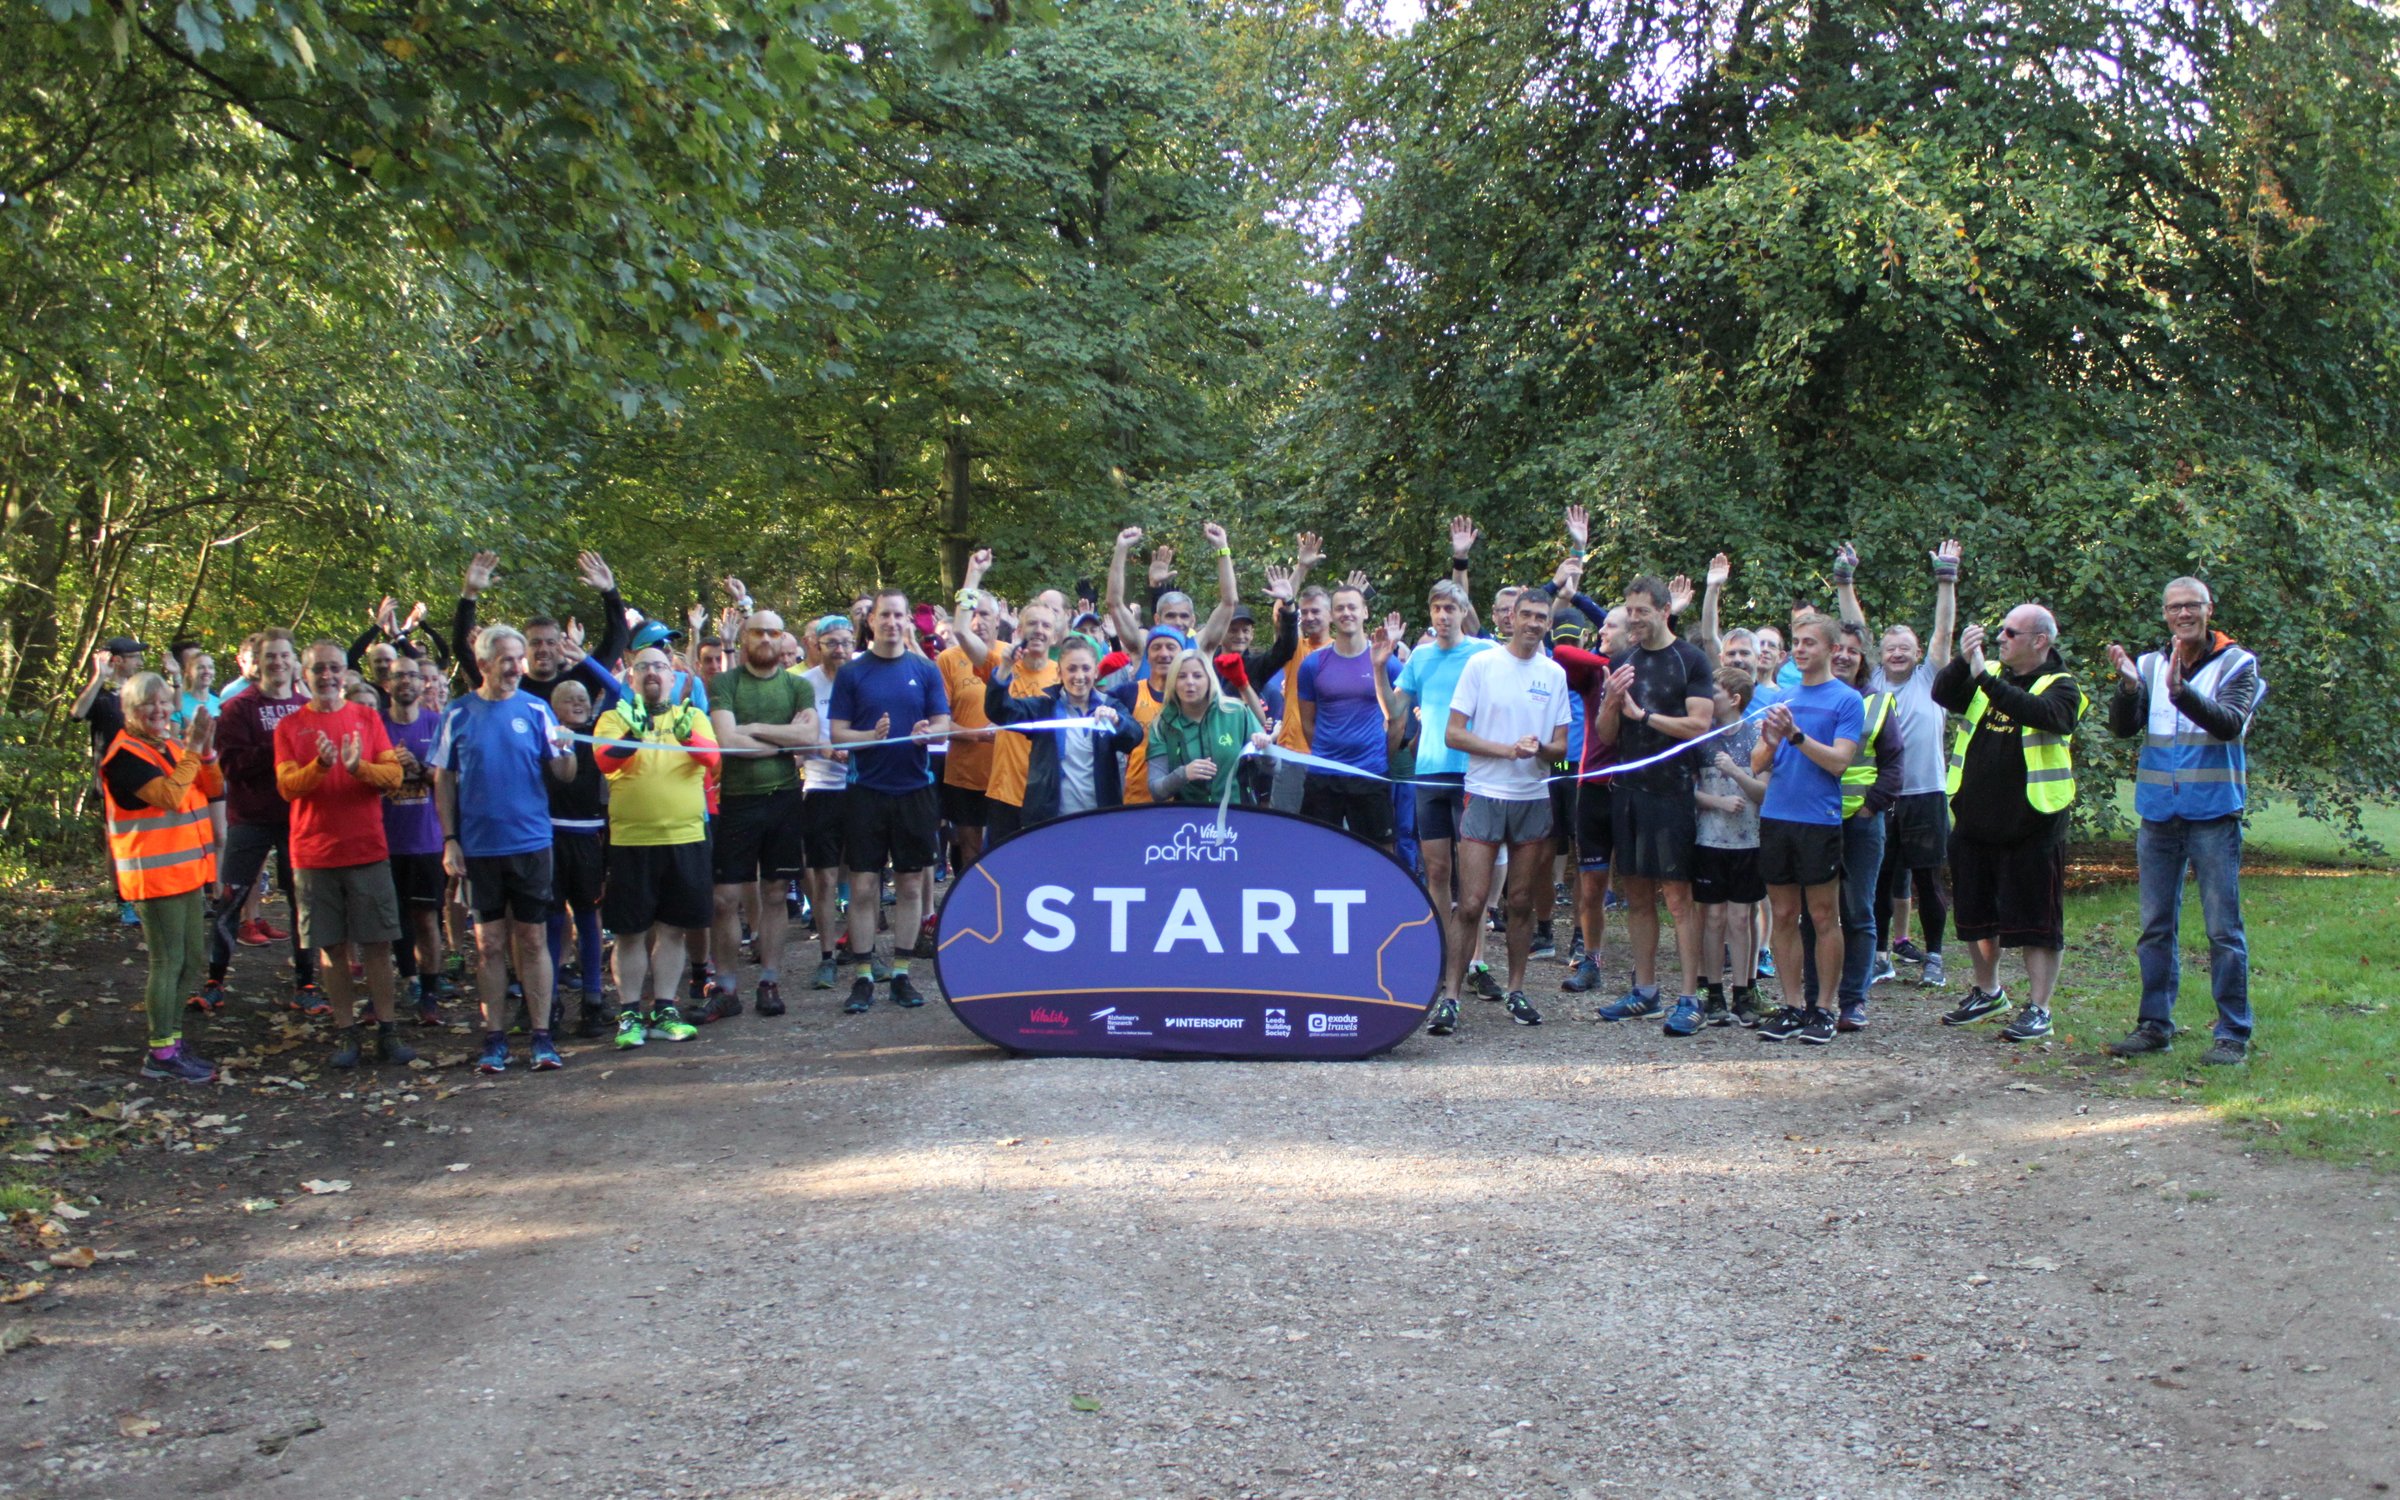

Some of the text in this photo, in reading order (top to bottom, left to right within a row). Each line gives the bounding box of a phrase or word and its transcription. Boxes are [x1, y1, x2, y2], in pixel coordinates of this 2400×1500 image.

[1200, 822, 1238, 844] Vitaity
[1144, 835, 1238, 865] parkrun
[1022, 884, 1367, 954] START
[1030, 1006, 1069, 1028] Vitality
[1328, 1014, 1359, 1023] exodus
[1176, 1018, 1244, 1029] INTERSPORT
[1265, 1023, 1292, 1031] Building
[1327, 1022, 1359, 1031] travels
[1265, 1030, 1290, 1038] Society
